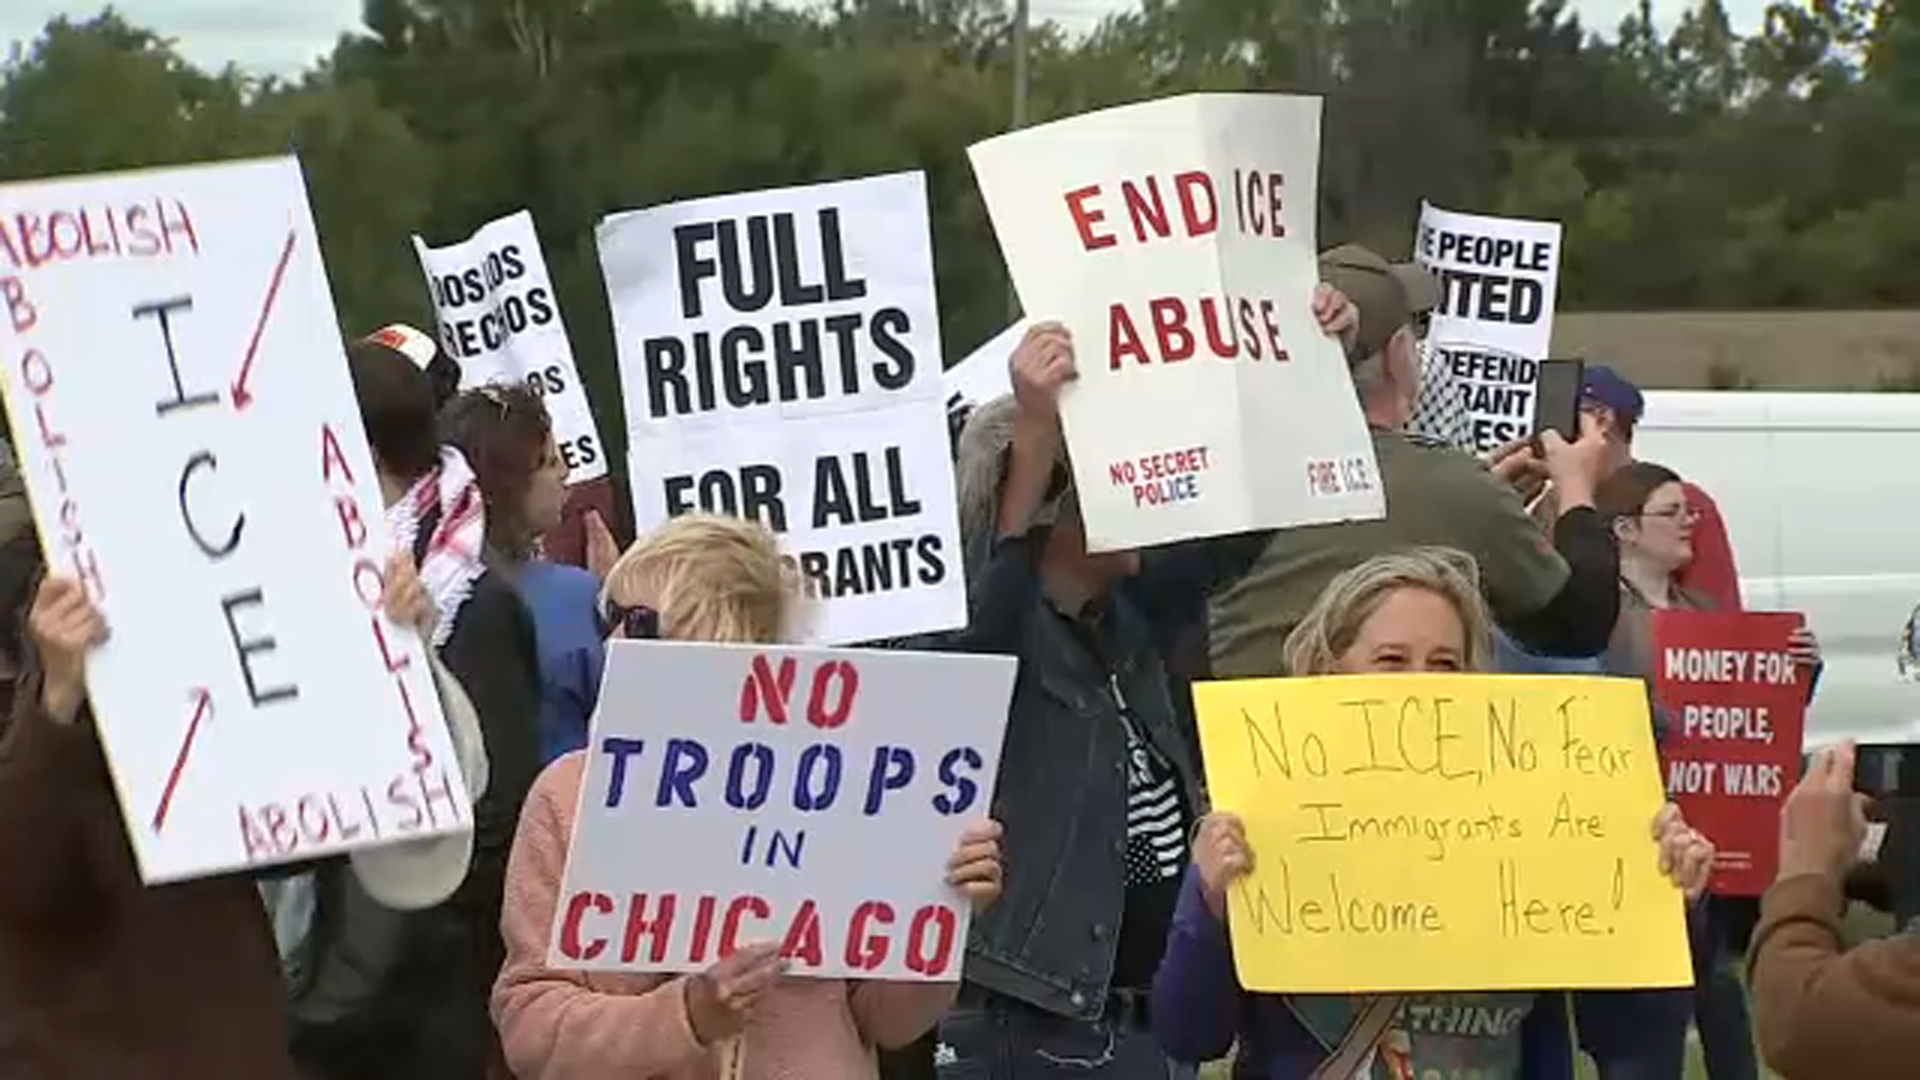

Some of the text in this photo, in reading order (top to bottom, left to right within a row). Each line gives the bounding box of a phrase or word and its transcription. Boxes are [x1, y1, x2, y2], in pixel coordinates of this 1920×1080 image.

[1063, 168, 1285, 252] END ICE
[673, 207, 867, 319] FULL
[1438, 229, 1551, 272] PEOPLE
[1109, 295, 1290, 371] ABUSE
[1432, 267, 1543, 325] ITED
[643, 307, 916, 418] RIGHTS
[663, 446, 921, 533] FOR ALL
[1109, 445, 1208, 486] NO SECRET
[1133, 474, 1198, 508] POLICE
[740, 653, 859, 728] NO
[1665, 647, 1797, 684] MONEY FOR
[1241, 701, 1328, 780] No
[1486, 697, 1538, 773] No
[1557, 695, 1634, 776] Fear
[1685, 704, 1774, 744] PEOPLE,
[602, 738, 983, 815] TROOPS
[1668, 761, 1783, 797] NOT WARS
[239, 770, 459, 863] ABOLISH
[741, 826, 805, 868] IN
[1296, 793, 1605, 861] Immigrants Are
[559, 892, 957, 977] CHICAGO
[1239, 857, 1626, 937] Welcome Here!
